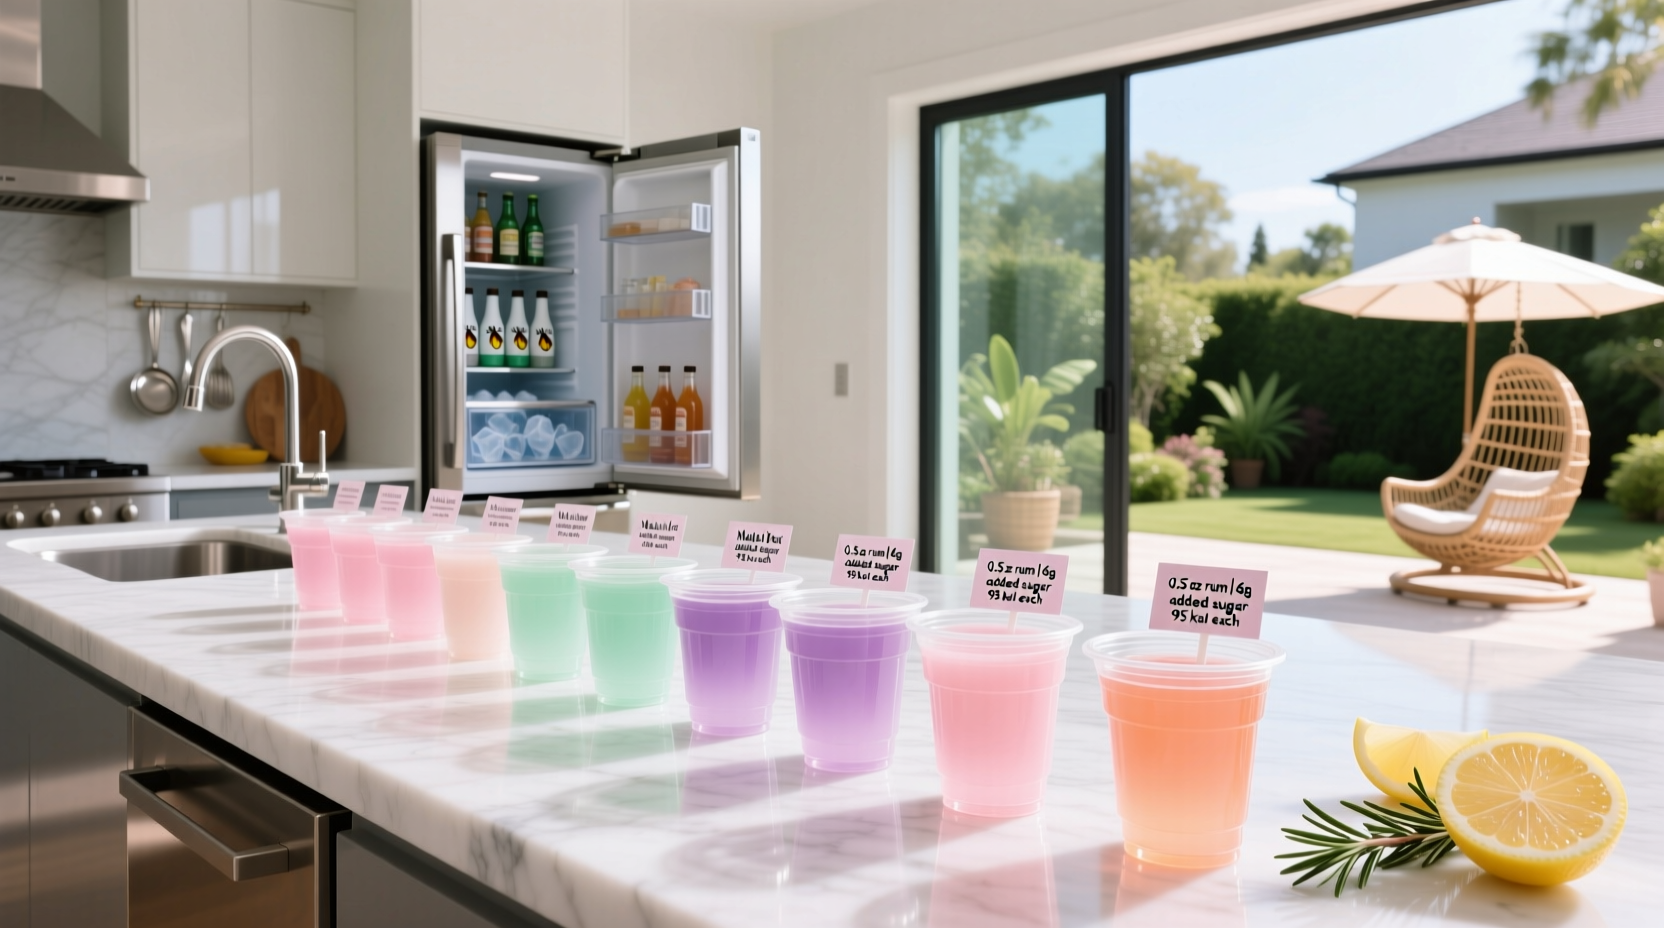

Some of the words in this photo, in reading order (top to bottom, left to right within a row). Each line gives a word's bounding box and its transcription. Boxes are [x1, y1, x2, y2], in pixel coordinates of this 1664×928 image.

[988, 560, 1004, 573] 0.5
[1015, 566, 1035, 575] rum
[1042, 565, 1056, 580] 6g
[1205, 583, 1228, 593] rum
[1236, 582, 1252, 598] 6g
[1170, 594, 1209, 608] added
[1212, 600, 1249, 615] sugar
[1171, 609, 1188, 622] 95
[1190, 609, 1208, 624] kal
[1212, 613, 1240, 627] each
